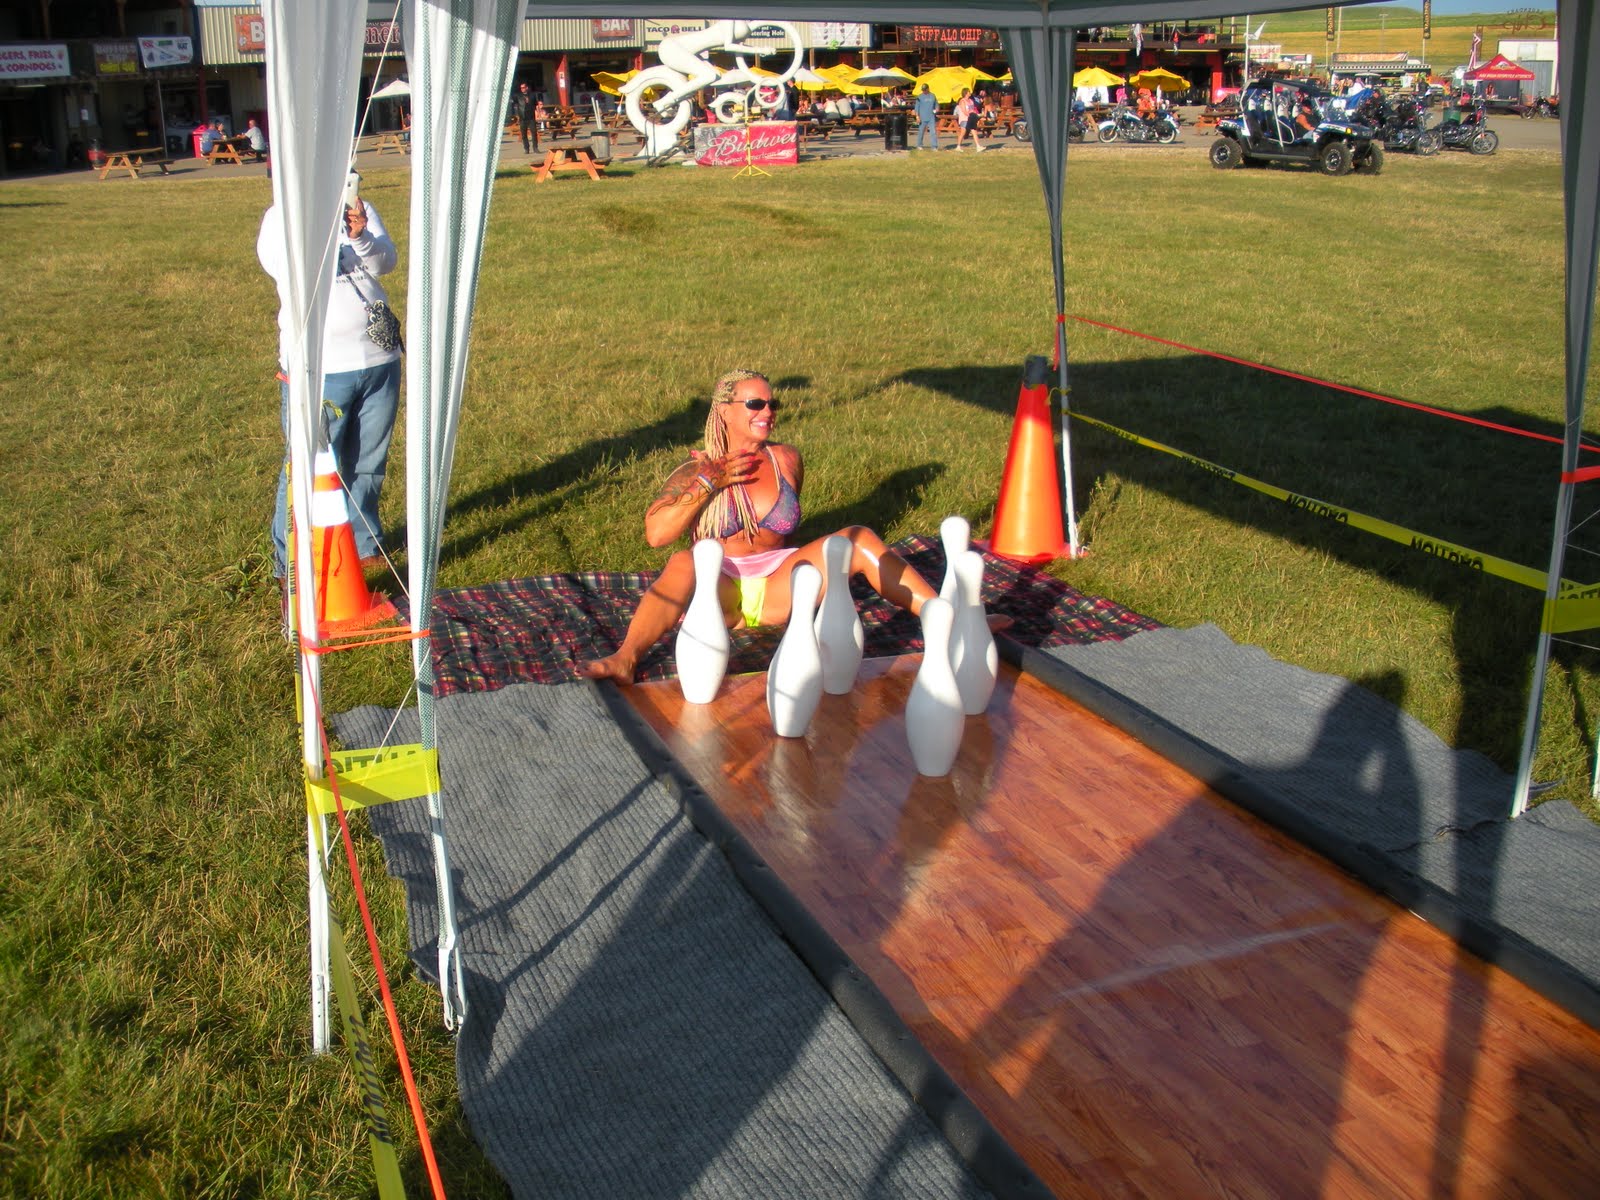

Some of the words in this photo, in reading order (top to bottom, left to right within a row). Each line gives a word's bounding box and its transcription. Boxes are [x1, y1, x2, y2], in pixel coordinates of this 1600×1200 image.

[365, 26, 400, 45] ner
[751, 30, 770, 38] atering
[914, 28, 957, 42] BUFFALO
[960, 28, 982, 41] CHIP
[6, 62, 56, 73] CORNDOGS
